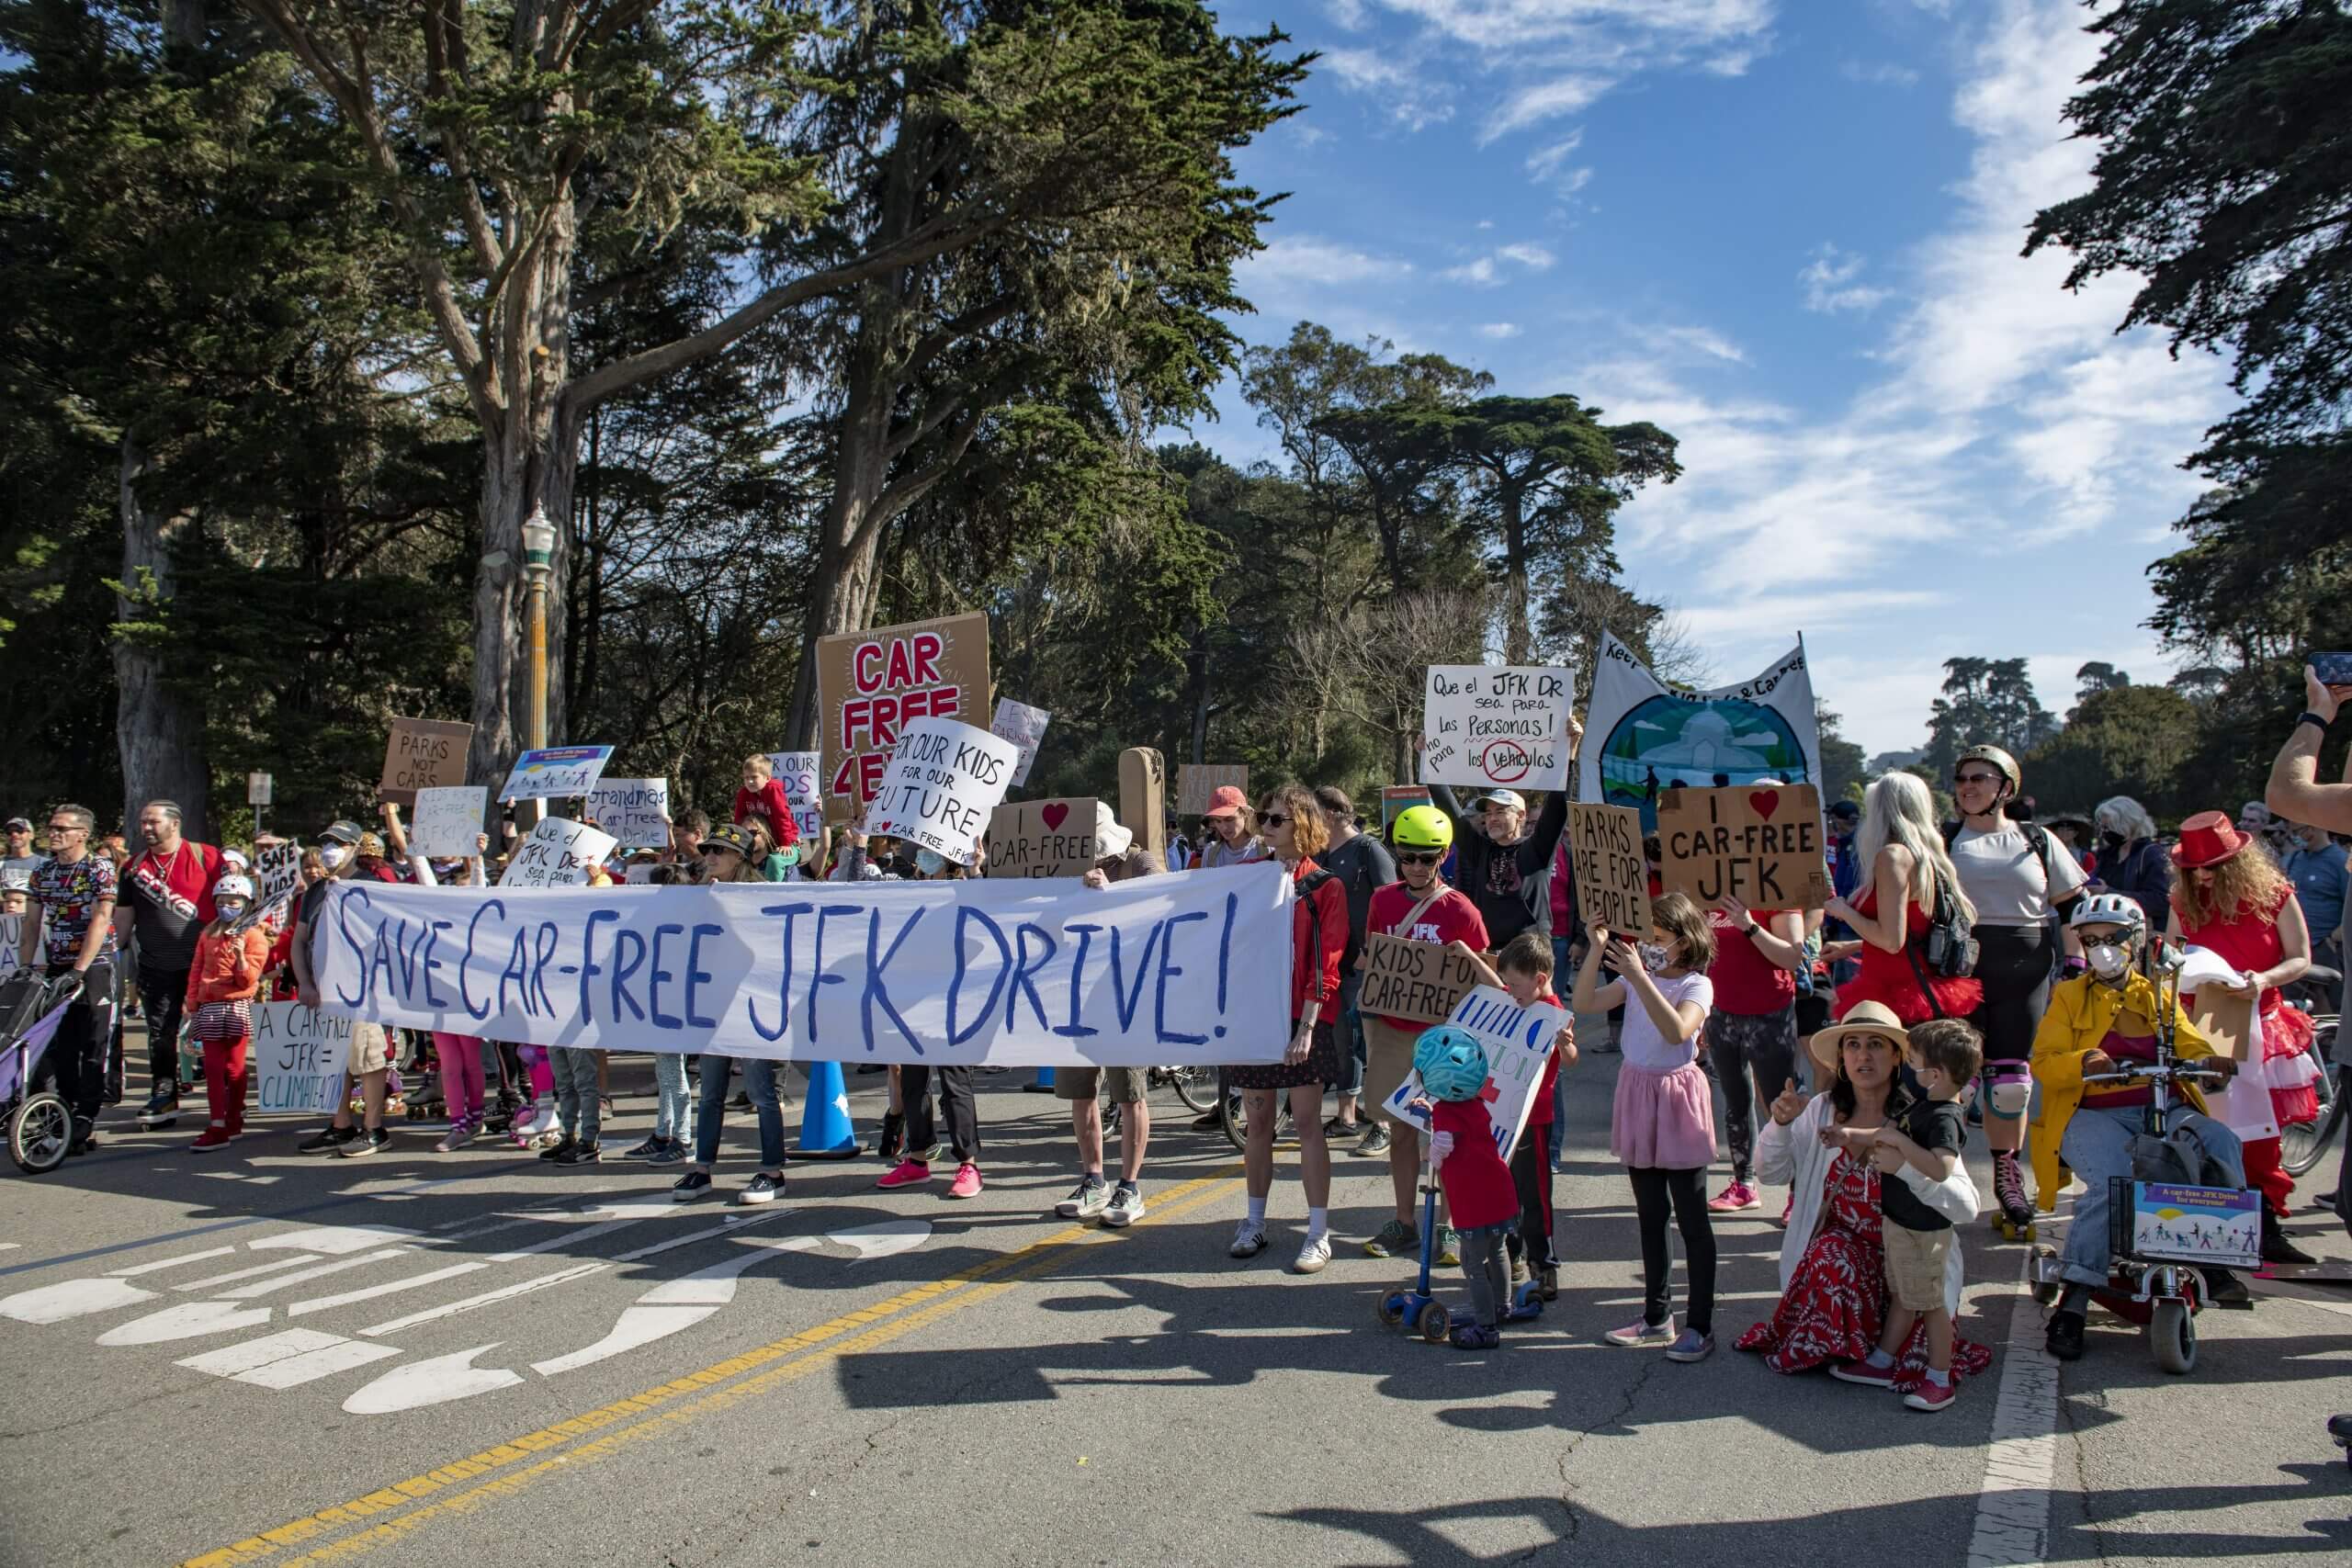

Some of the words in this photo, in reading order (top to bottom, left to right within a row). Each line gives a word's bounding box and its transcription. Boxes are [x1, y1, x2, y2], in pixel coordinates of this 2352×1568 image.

[853, 631, 943, 695] CAR
[1433, 673, 1459, 697] Que
[1464, 677, 1477, 694] el
[1492, 671, 1530, 696] JFK
[1538, 675, 1564, 697] DR
[1475, 697, 1505, 709] sea
[1439, 716, 1458, 734] Las
[400, 735, 449, 760] PARKS
[912, 733, 949, 765] OUR
[953, 741, 1005, 785] KIDS
[1426, 737, 1441, 752] no
[1429, 744, 1455, 773] para
[1468, 749, 1484, 768] los
[412, 758, 438, 772] NOT
[786, 756, 817, 773] OUR
[900, 765, 921, 780] FOR
[926, 768, 956, 791] OUR
[396, 771, 438, 789] CARS
[787, 795, 806, 807] OUR
[869, 785, 981, 838] FUTURE
[1709, 795, 1718, 824] I
[625, 806, 660, 826] Free
[1018, 807, 1023, 834] I
[535, 820, 559, 842] Que
[563, 829, 583, 846] el
[891, 823, 915, 840] CAR
[919, 831, 944, 851] FREE
[1573, 807, 1631, 855] PARKS
[1670, 822, 1815, 860] CAR-FREE
[261, 839, 296, 874] SAFE
[519, 842, 550, 866] JFK
[557, 851, 580, 870] DR
[991, 835, 1091, 868] CAR-FREE
[264, 869, 297, 900] KIDS
[1575, 848, 1602, 884] ARE
[1609, 852, 1644, 893] FOR
[1698, 856, 1784, 903] JFK
[1583, 885, 1644, 931] PEOPLE
[1411, 923, 1442, 940] JFK
[1371, 939, 1426, 978] KIDS
[748, 901, 925, 1055] JFK
[1362, 972, 1460, 1018] CAR-FREE
[258, 1007, 274, 1041] A
[287, 1003, 352, 1043] CAR-FREE
[278, 1043, 319, 1073] JFK
